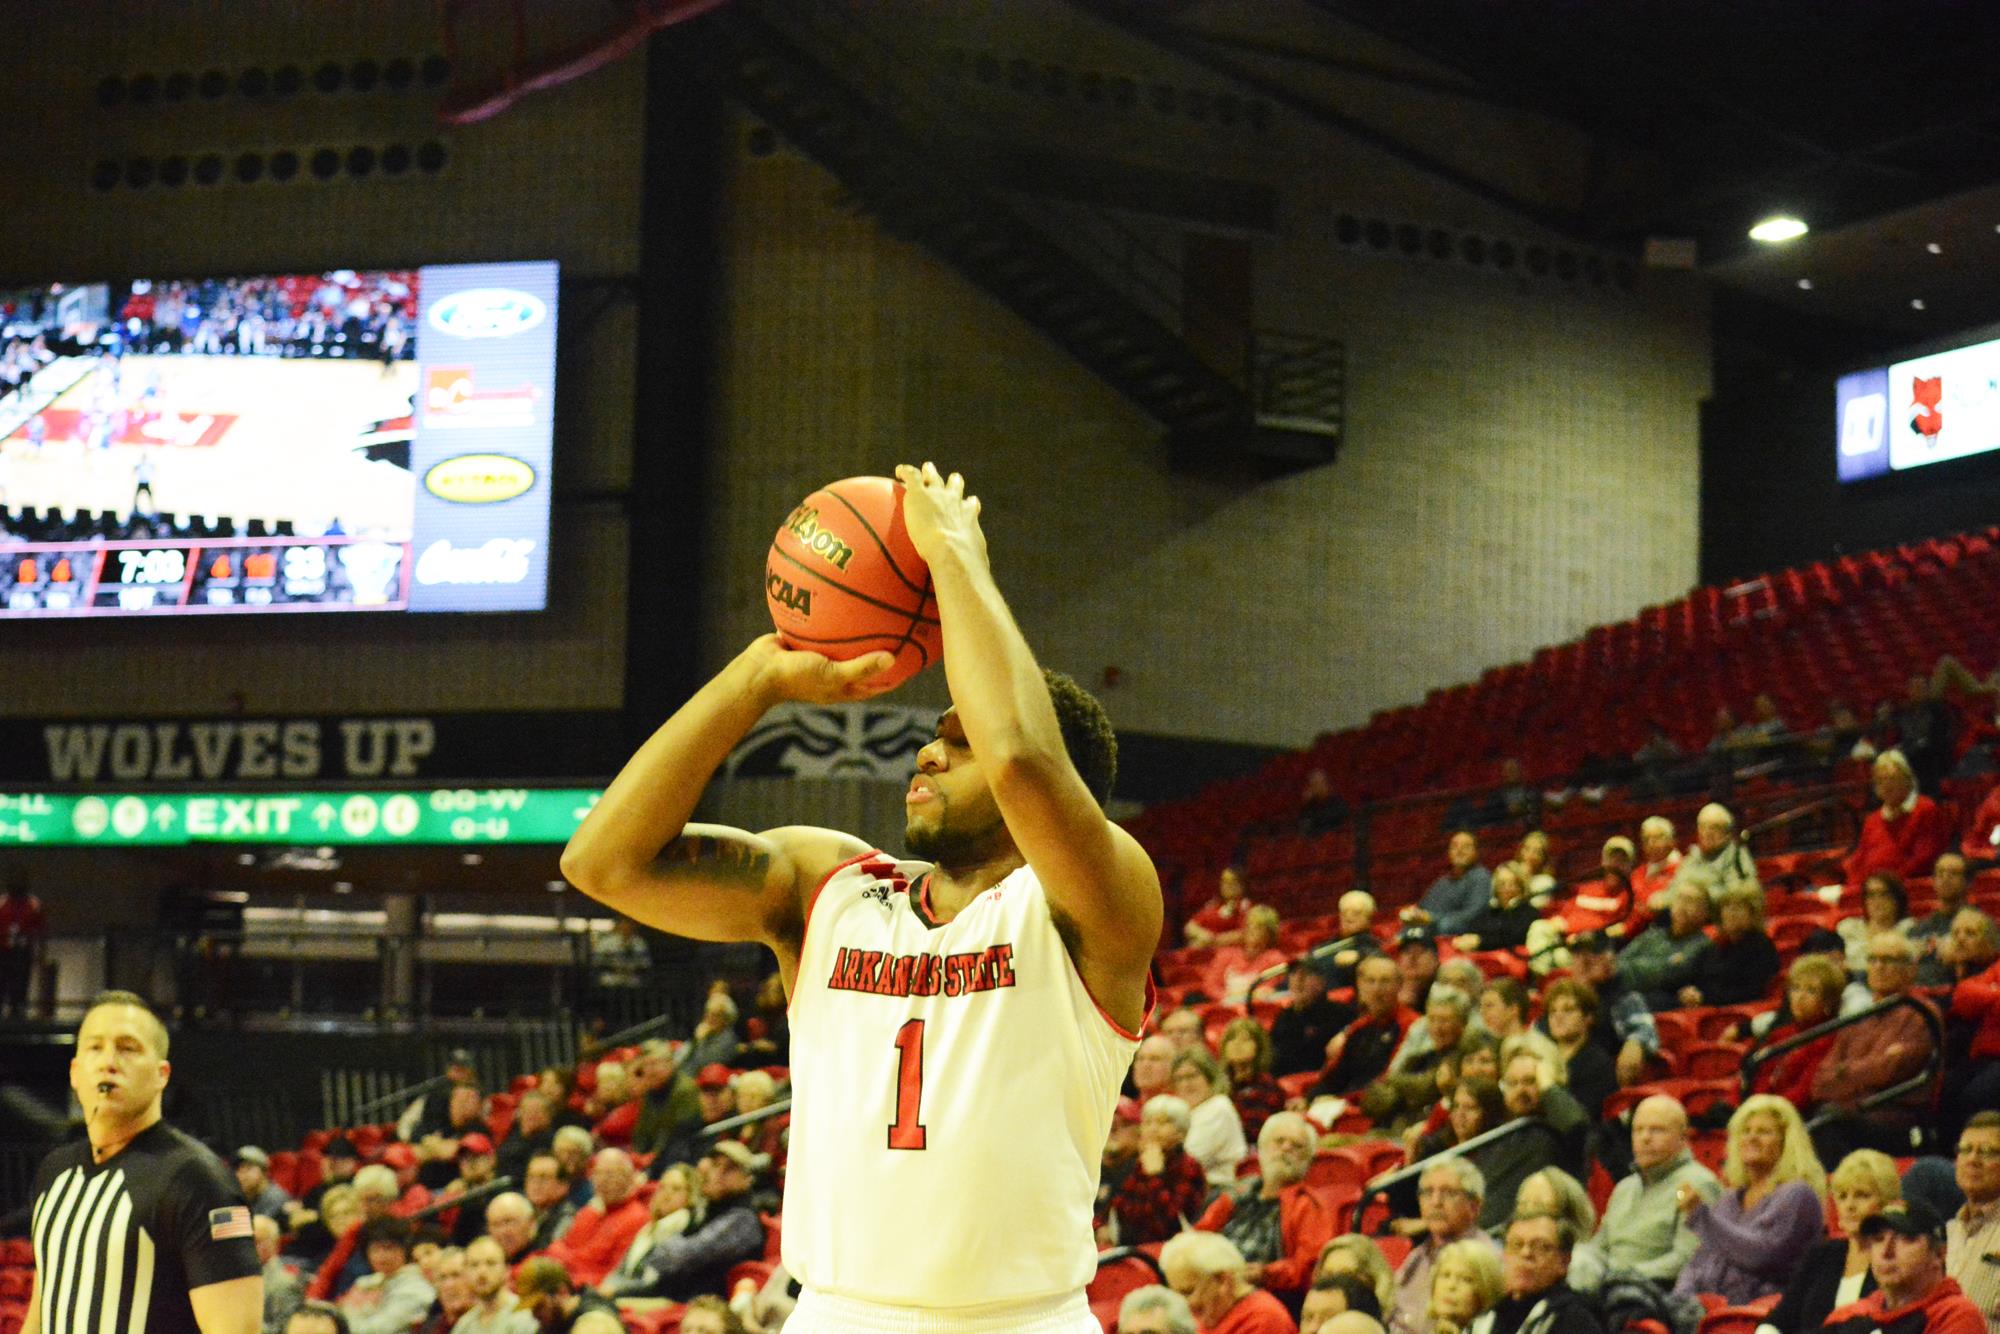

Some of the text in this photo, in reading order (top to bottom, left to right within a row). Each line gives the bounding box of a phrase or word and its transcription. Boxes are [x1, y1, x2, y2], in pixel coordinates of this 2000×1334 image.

[767, 567, 811, 617] CAA
[45, 720, 435, 780] WOLVES UP
[185, 798, 301, 835] EXIT
[828, 943, 1016, 998] ARKANSAS STATE
[887, 1018, 926, 1150] 1
